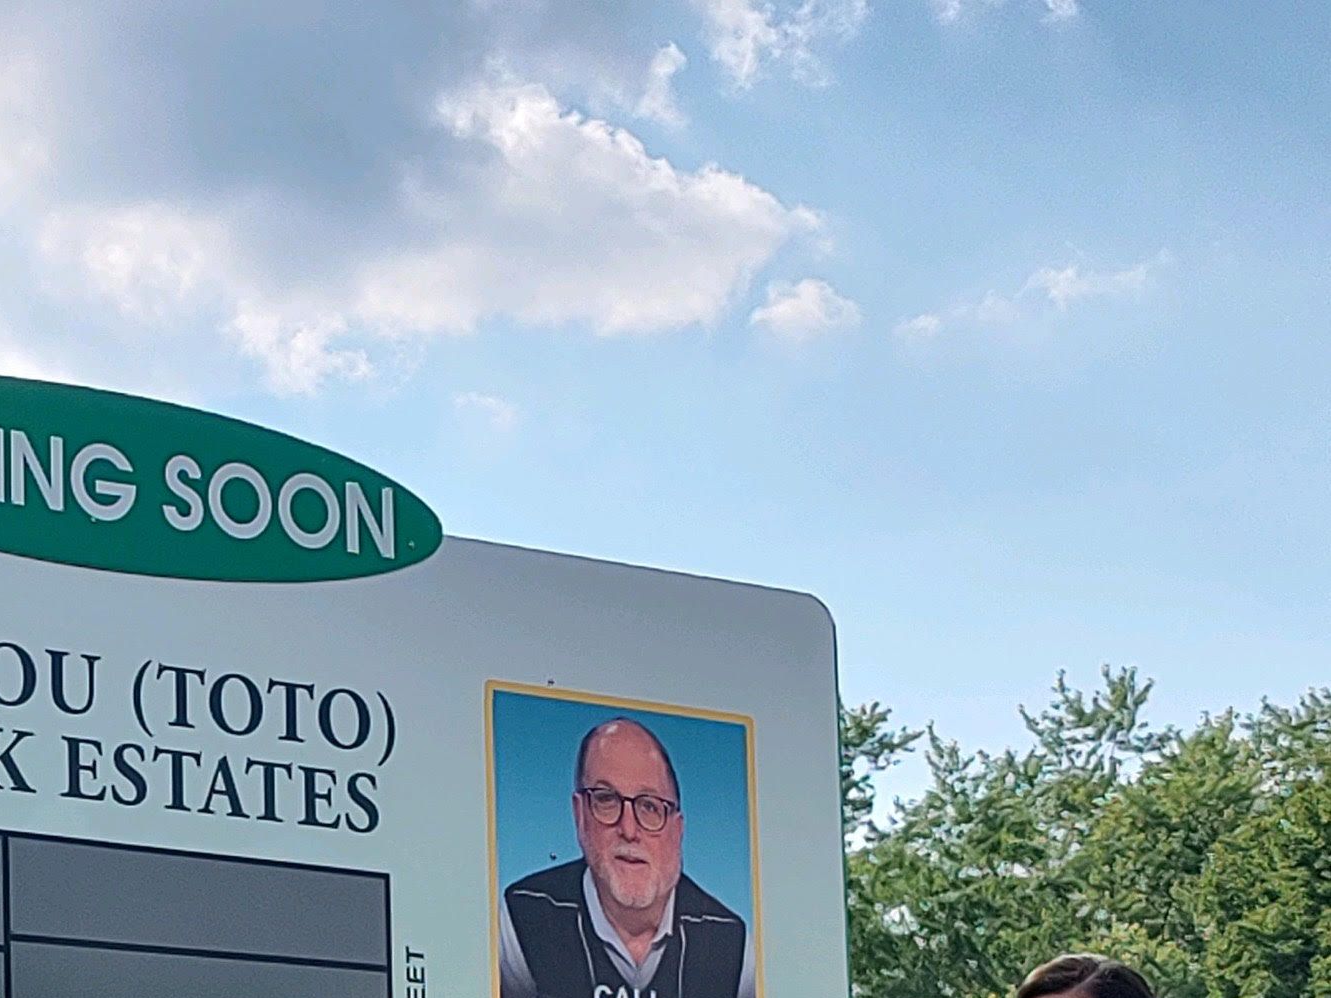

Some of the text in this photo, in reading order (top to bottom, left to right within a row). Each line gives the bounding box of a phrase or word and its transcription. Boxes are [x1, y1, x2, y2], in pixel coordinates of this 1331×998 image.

[162, 454, 396, 560] SOON
[132, 659, 397, 767] (TOTO)
[59, 735, 380, 834] ESTATES
